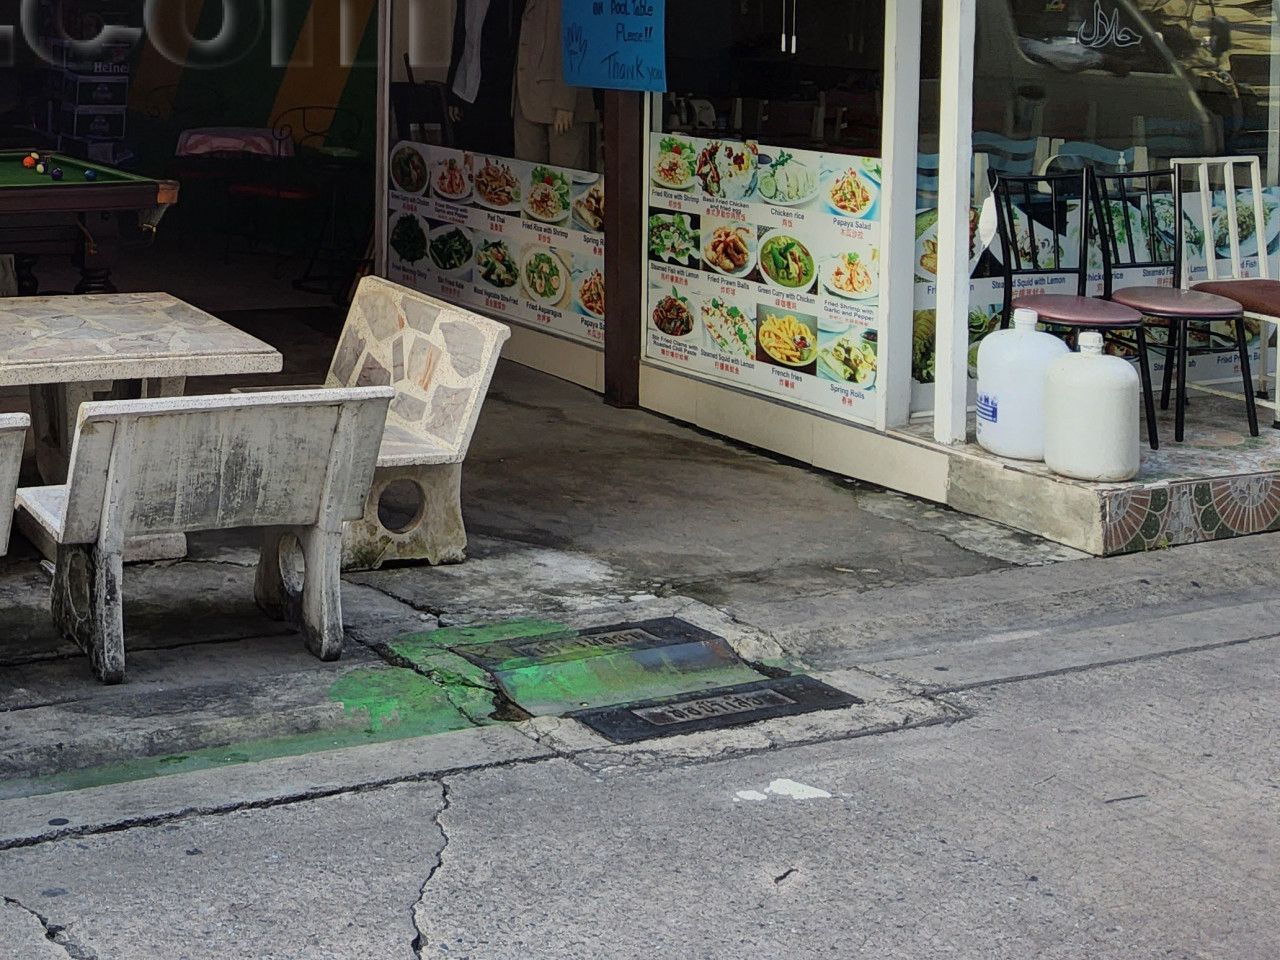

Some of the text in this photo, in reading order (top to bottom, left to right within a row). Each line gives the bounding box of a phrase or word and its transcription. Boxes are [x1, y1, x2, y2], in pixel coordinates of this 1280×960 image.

[651, 189, 662, 197] Fried
[683, 195, 699, 204] Shrimp
[729, 200, 749, 209] Chicken
[496, 215, 505, 223] Thai
[770, 208, 804, 219] Chicken rice
[522, 221, 568, 239] Fried Rice with Shrimp
[832, 217, 872, 231] Papaya Salad
[583, 234, 599, 246] Spring
[685, 271, 699, 279] Lemon
[707, 274, 749, 290] Fried Prawn Balls
[1017, 278, 1033, 288] Squid
[1034, 277, 1046, 285] with
[1047, 276, 1066, 285] Lemon
[757, 286, 815, 305] Green Curry with Chicken
[526, 301, 538, 310] Fried
[823, 299, 838, 308] Fried
[840, 303, 861, 313] Shrimp
[823, 306, 840, 314] Garlic
[853, 312, 874, 322] Pepper
[581, 316, 599, 329] Papaya
[660, 336, 673, 344] Fried
[718, 353, 730, 363] Squid
[730, 357, 740, 365] with
[740, 360, 755, 370] Lemon
[771, 366, 803, 382] French fries
[829, 383, 865, 400] Spring Rolls
